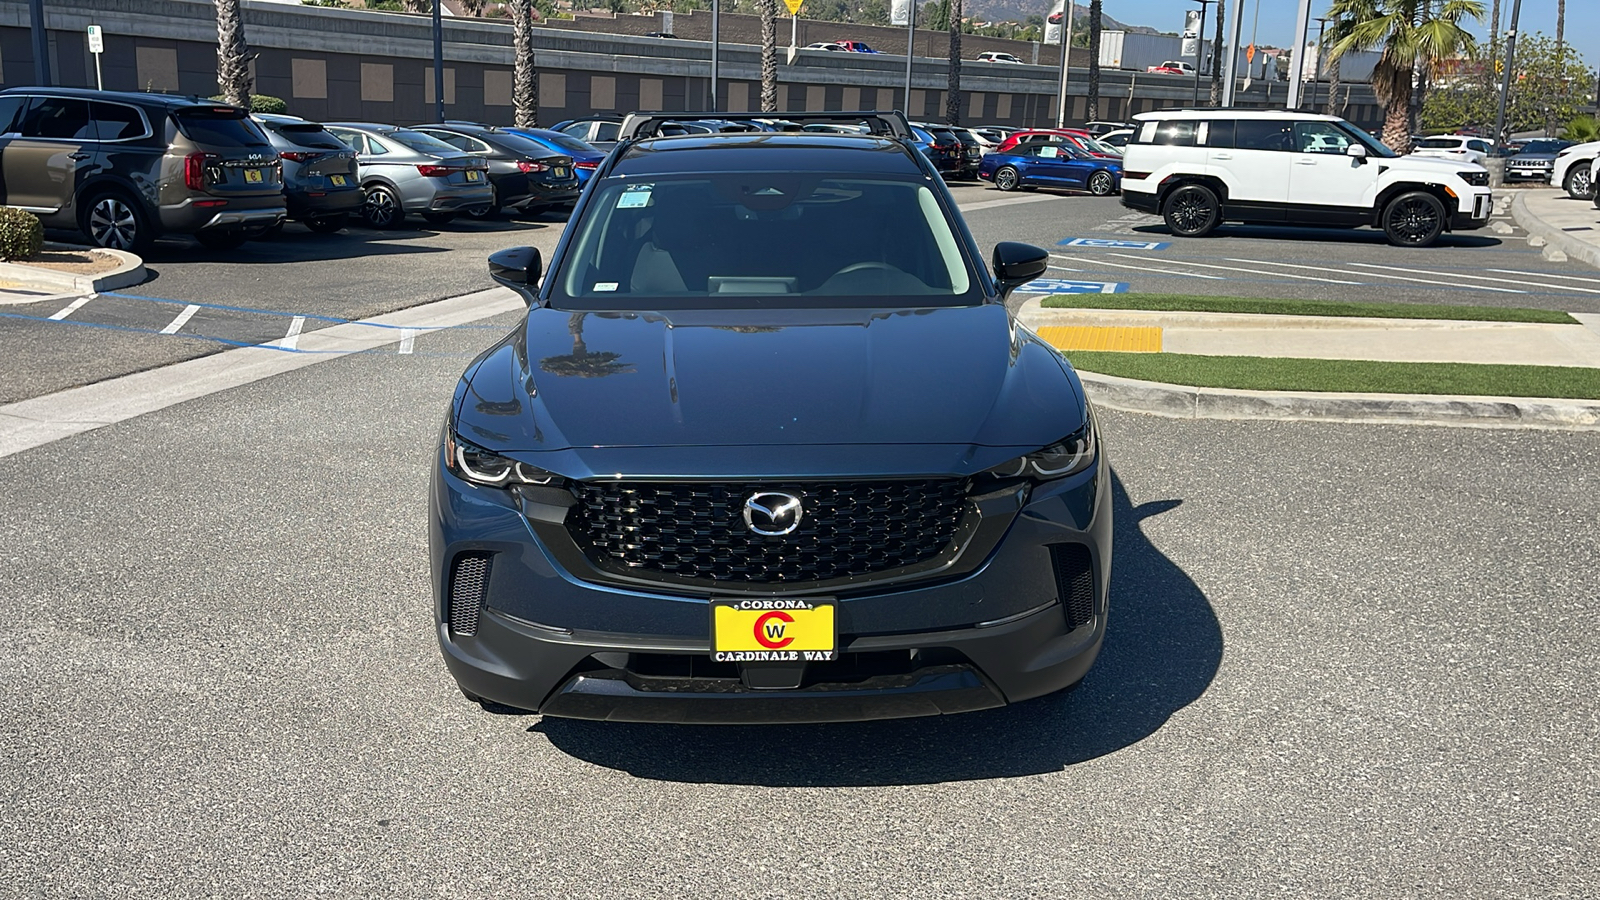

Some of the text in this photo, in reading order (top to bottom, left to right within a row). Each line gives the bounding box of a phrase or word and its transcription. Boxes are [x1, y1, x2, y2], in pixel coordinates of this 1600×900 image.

[740, 600, 807, 610] CORONA
[715, 651, 833, 662] CARDINALE WAY
